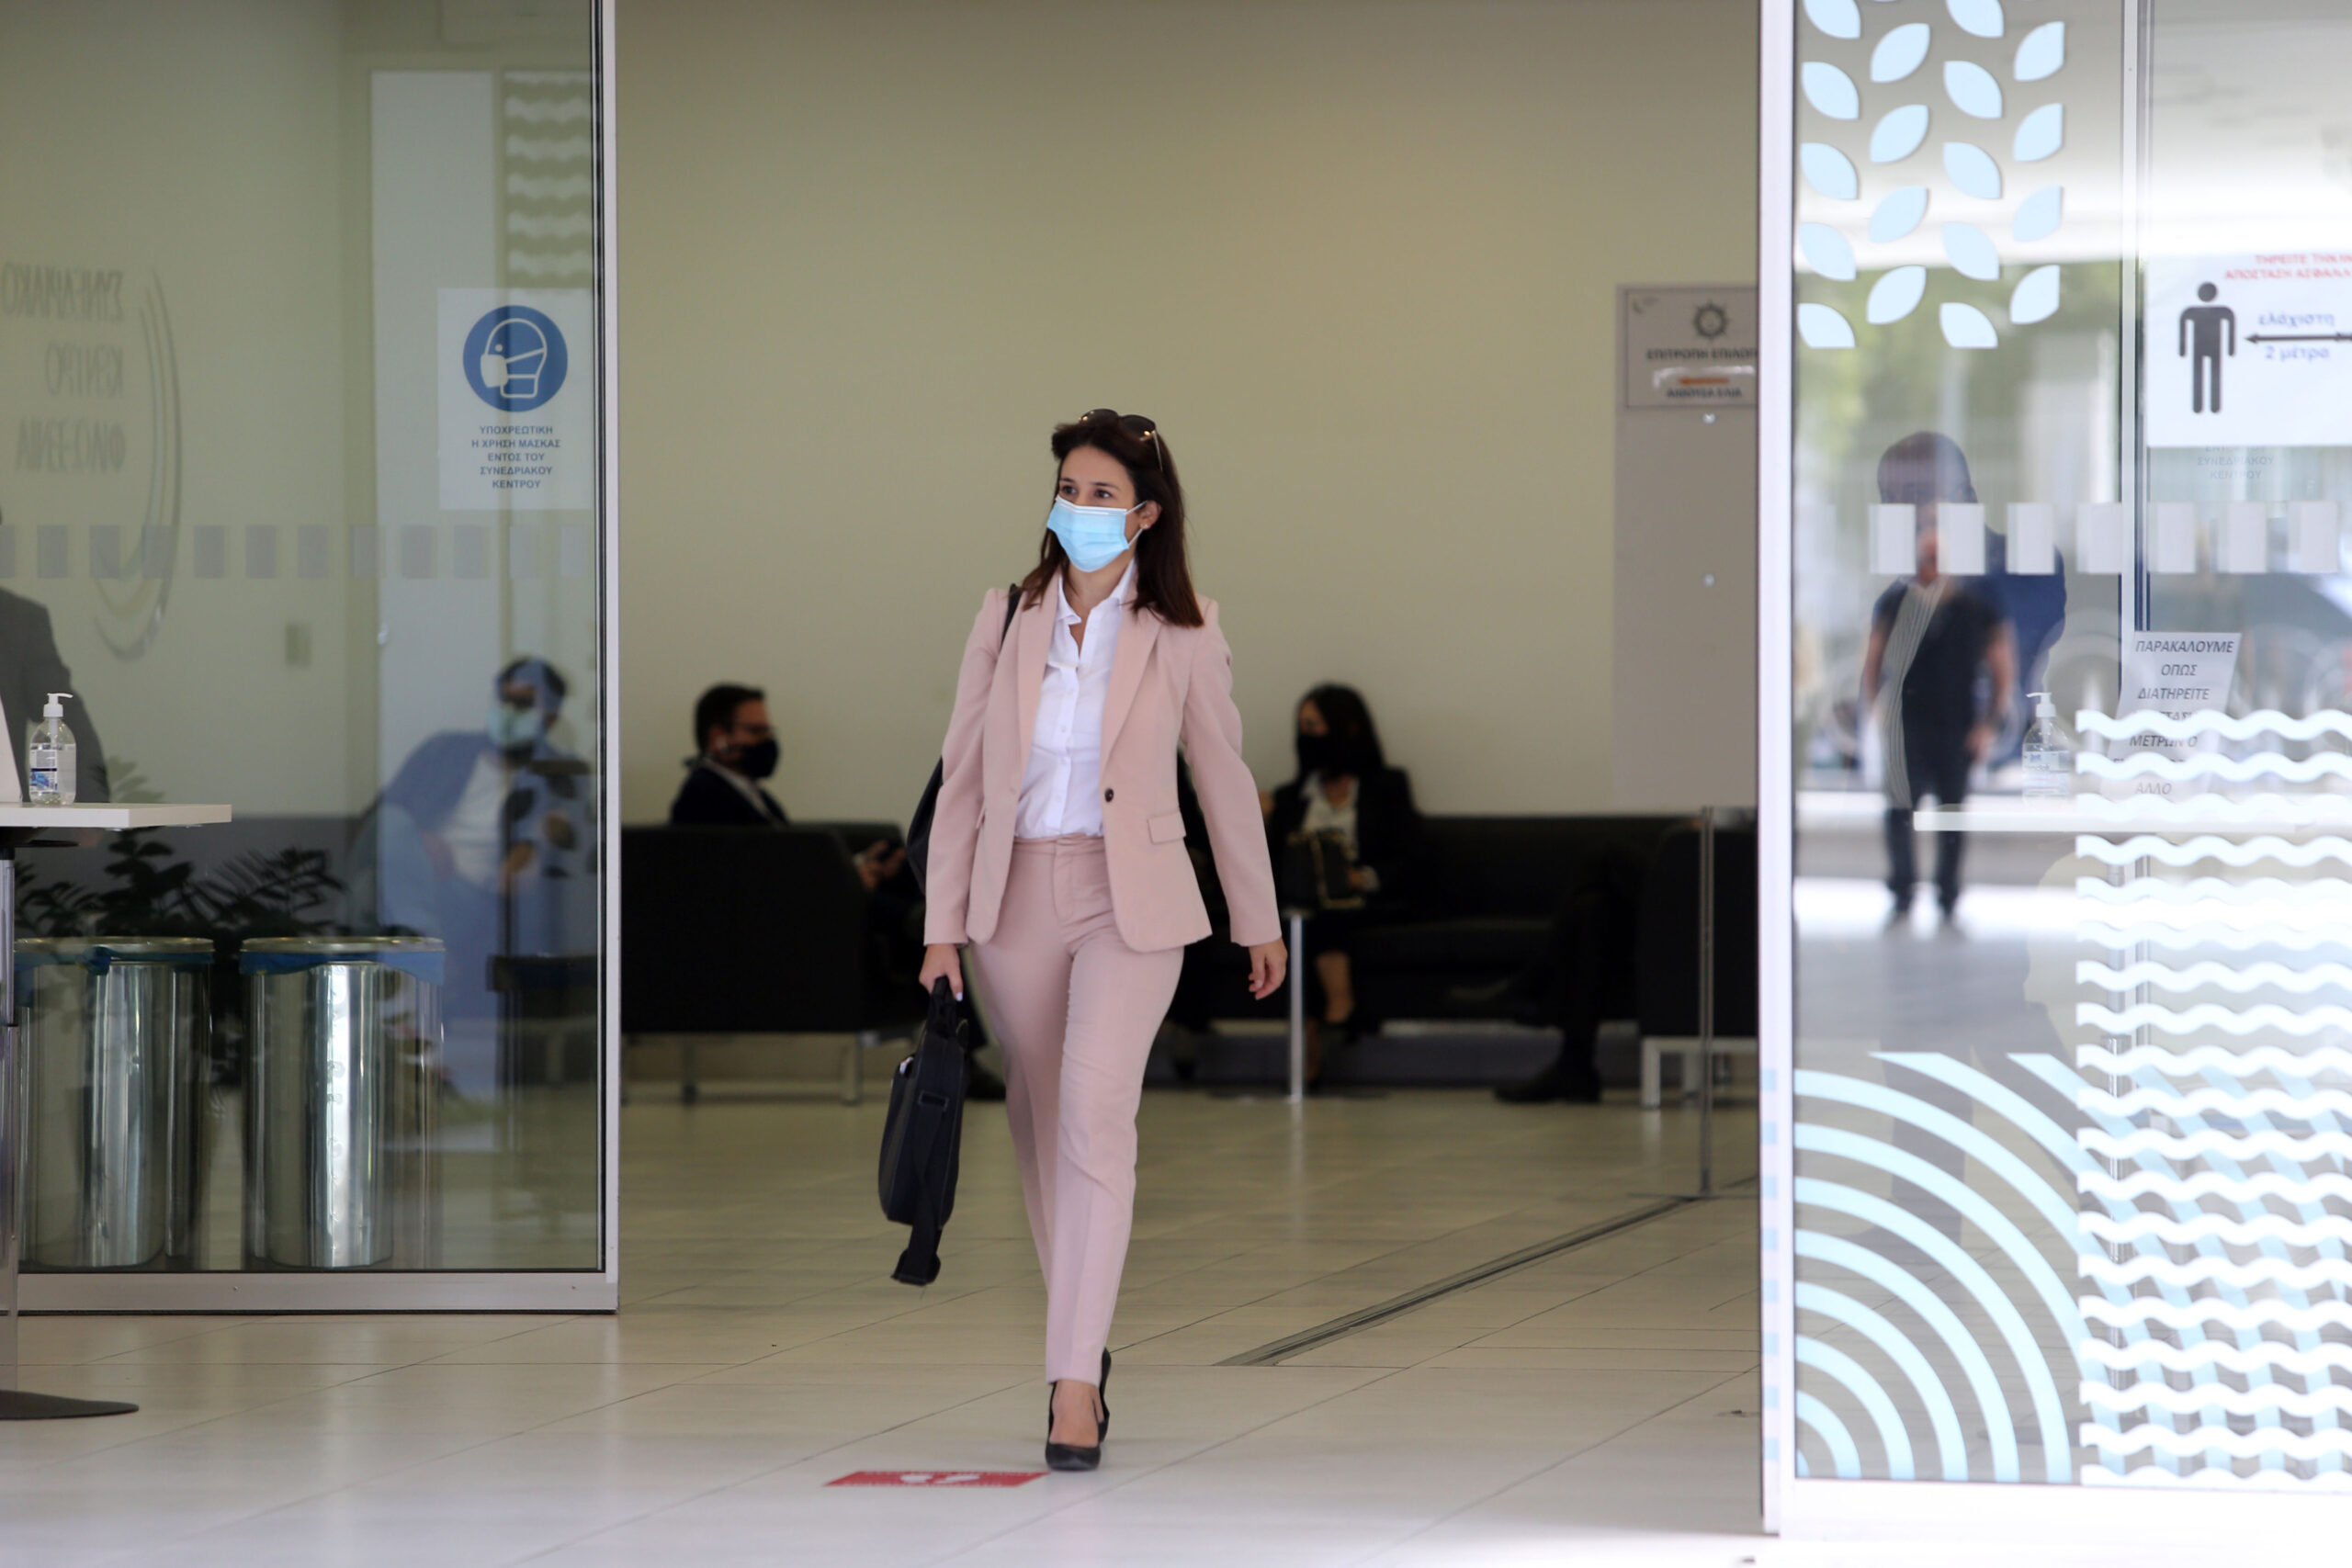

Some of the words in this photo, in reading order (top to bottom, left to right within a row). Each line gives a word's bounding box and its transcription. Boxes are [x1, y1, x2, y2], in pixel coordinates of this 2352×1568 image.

[2265, 344, 2276, 360] 2
[480, 425, 553, 434] ΥΠΟΧΡΕΩΤΙΚΗ
[471, 439, 480, 448] Η
[481, 439, 516, 448] ΧΡΗΣΗ
[518, 439, 561, 448] ΜΑΣΚΑΣ
[488, 453, 522, 462] ΕΝΤΟΣ
[525, 453, 545, 461] ΤΟΥ
[480, 466, 553, 475] ΣΥΝΕΔΡΙΑΚΟΥ
[492, 479, 541, 489] ΚΕΝΤΡΟΥ
[2135, 640, 2234, 653] ΠΑΡΑΚΑΛΟΥΜΕ
[2161, 663, 2198, 676] ΟΠΩΣ
[2137, 687, 2210, 700] ΔΙΑΤΗΡΕΙΤΕ
[2135, 783, 2172, 795] ΑΛΛΟ
